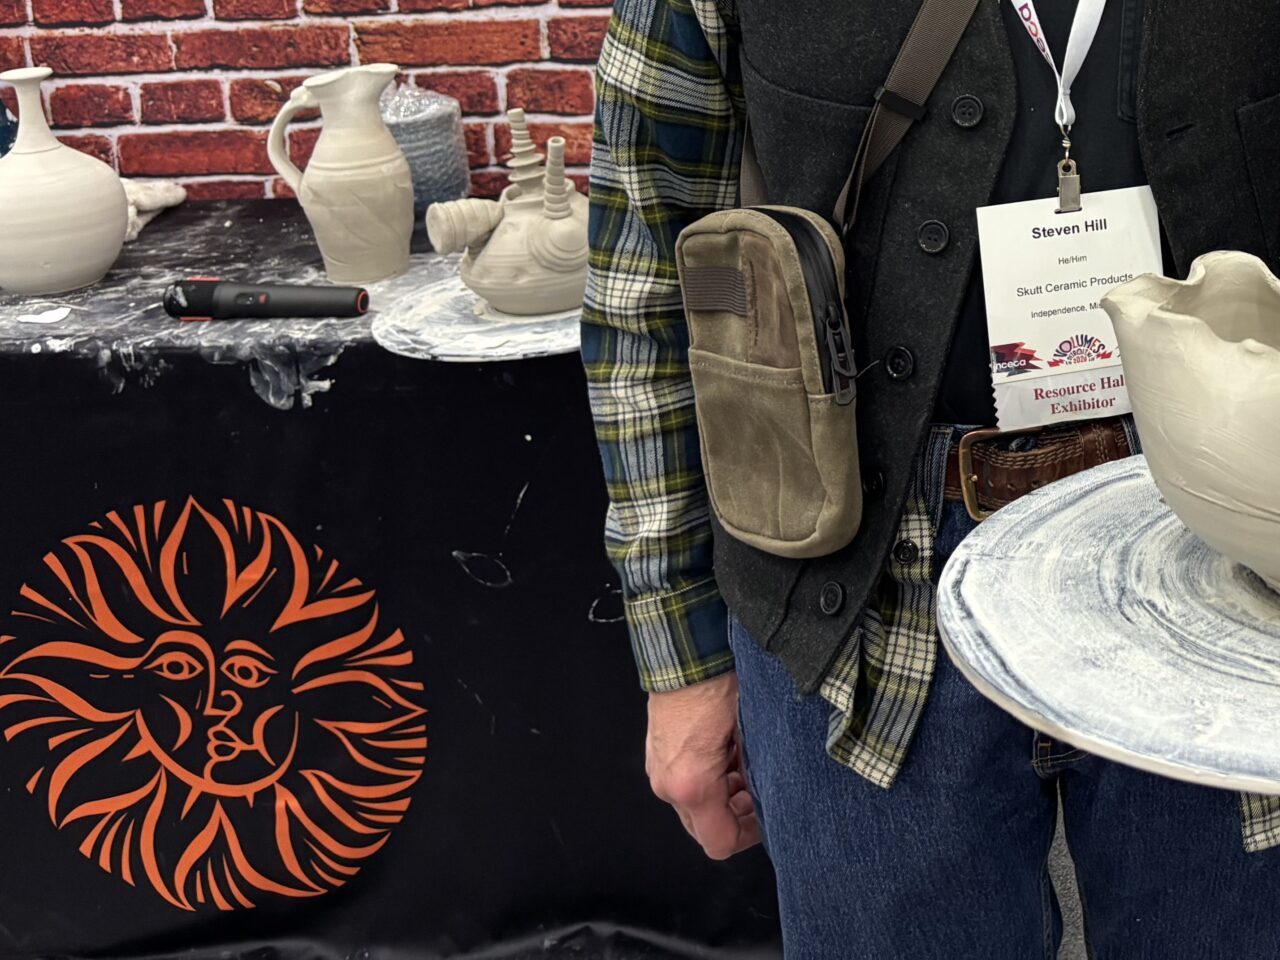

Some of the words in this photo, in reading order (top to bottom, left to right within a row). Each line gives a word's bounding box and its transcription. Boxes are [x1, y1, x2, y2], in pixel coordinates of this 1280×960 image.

[1032, 224, 1080, 239] Steven
[1085, 218, 1107, 232] Hill
[1058, 255, 1087, 265] He/Him
[1017, 285, 1043, 297] Skutt
[1045, 279, 1088, 293] Ceramic
[1053, 334, 1105, 357] VOLUMES
[1034, 383, 1097, 401] Resource
[1051, 397, 1116, 414] Exhibitor
